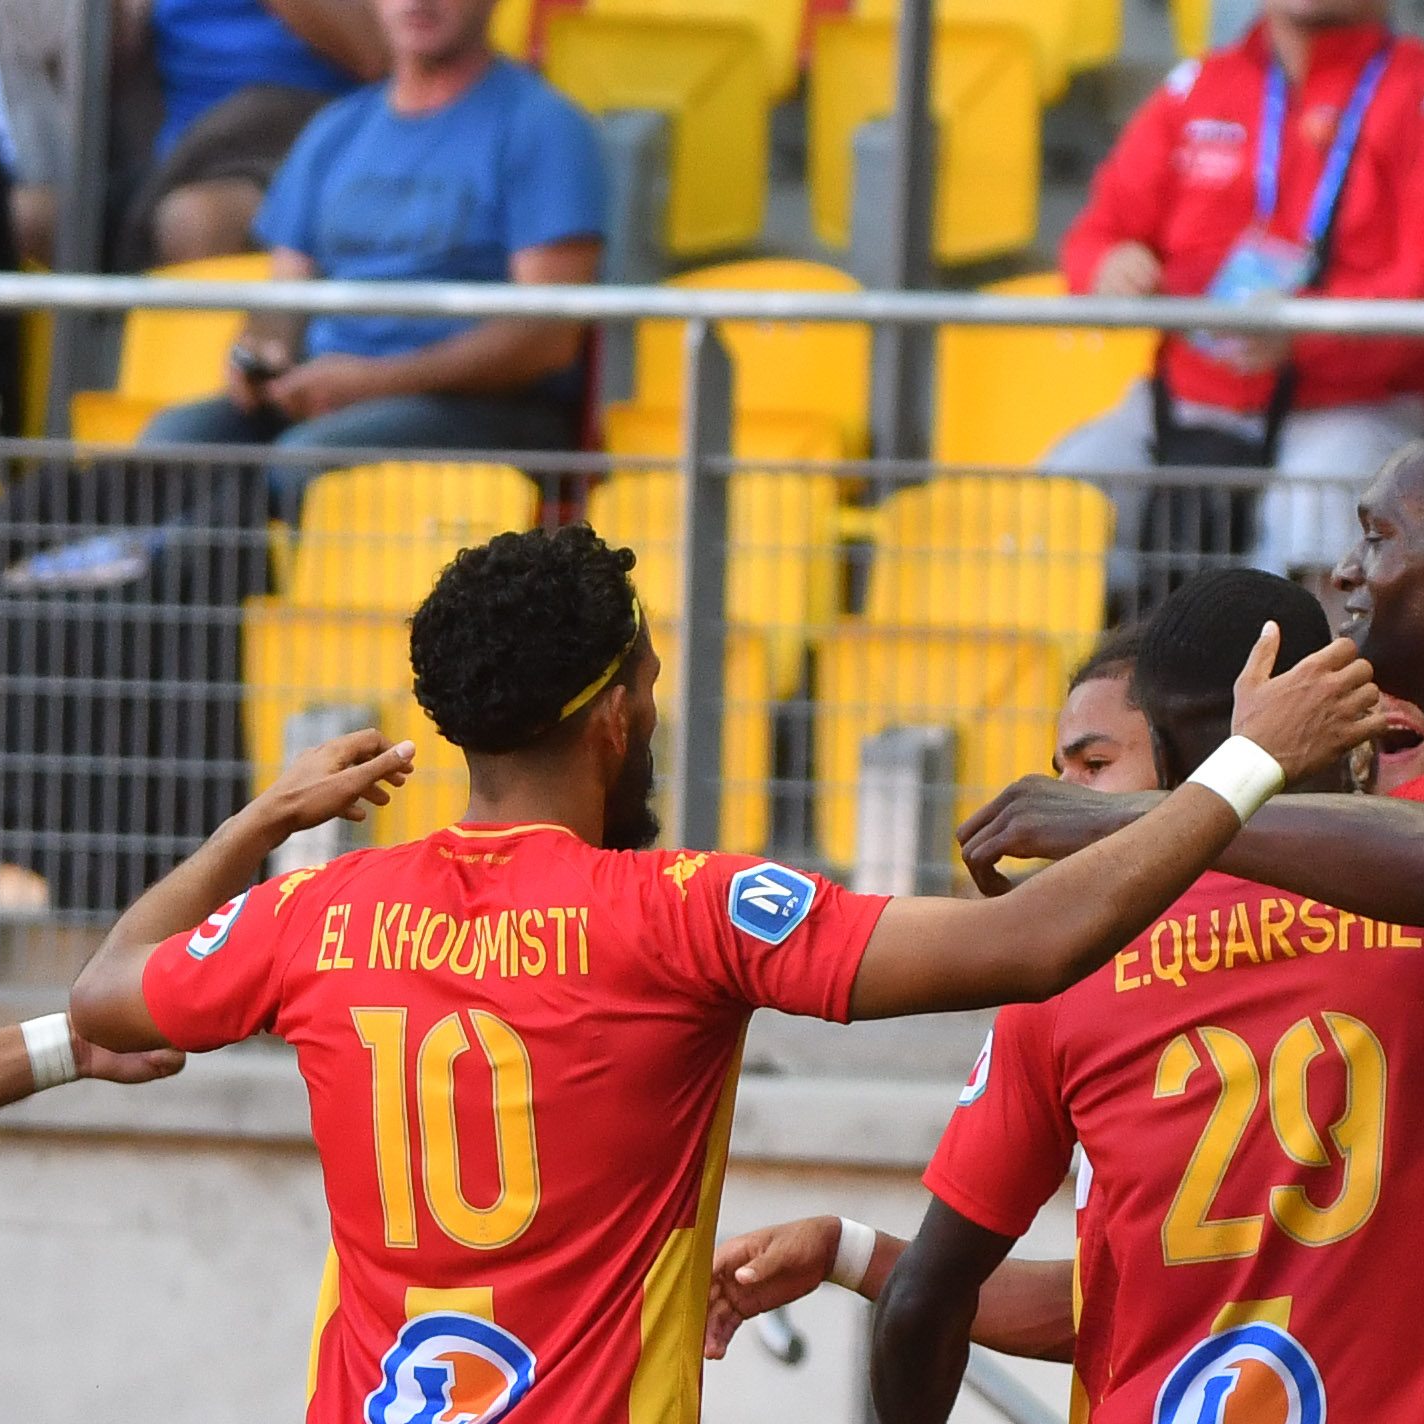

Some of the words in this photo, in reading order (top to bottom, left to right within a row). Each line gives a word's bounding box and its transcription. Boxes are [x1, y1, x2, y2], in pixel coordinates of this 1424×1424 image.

[316, 903, 355, 972] EL
[367, 901, 589, 981] KHOUMISTI
[349, 1006, 541, 1250] 10
[1152, 1011, 1387, 1267] 29
